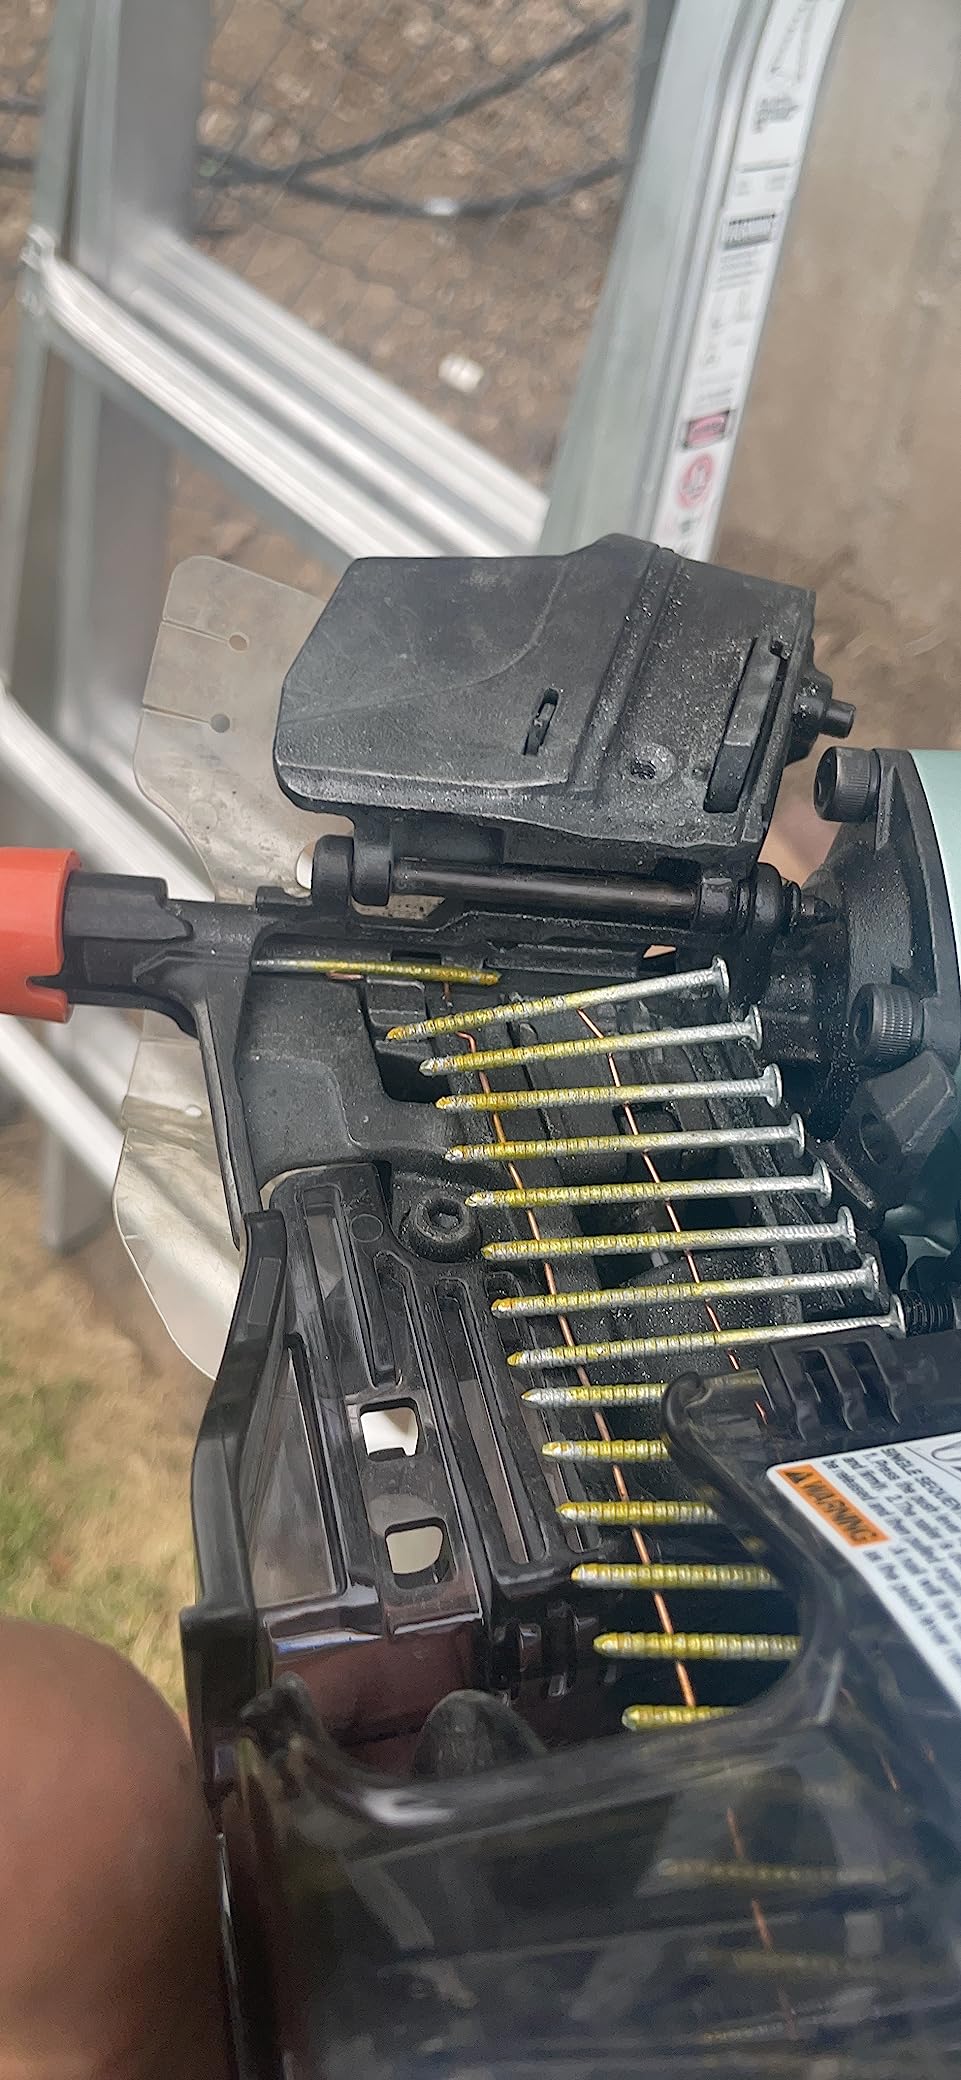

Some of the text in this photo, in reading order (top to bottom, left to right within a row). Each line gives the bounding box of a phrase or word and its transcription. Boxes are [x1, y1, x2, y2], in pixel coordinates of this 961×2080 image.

[843, 1457, 866, 1469] and
[876, 1460, 900, 1481] Press
[881, 1448, 922, 1476] SINGLE
[804, 1480, 877, 1542] WARNING
